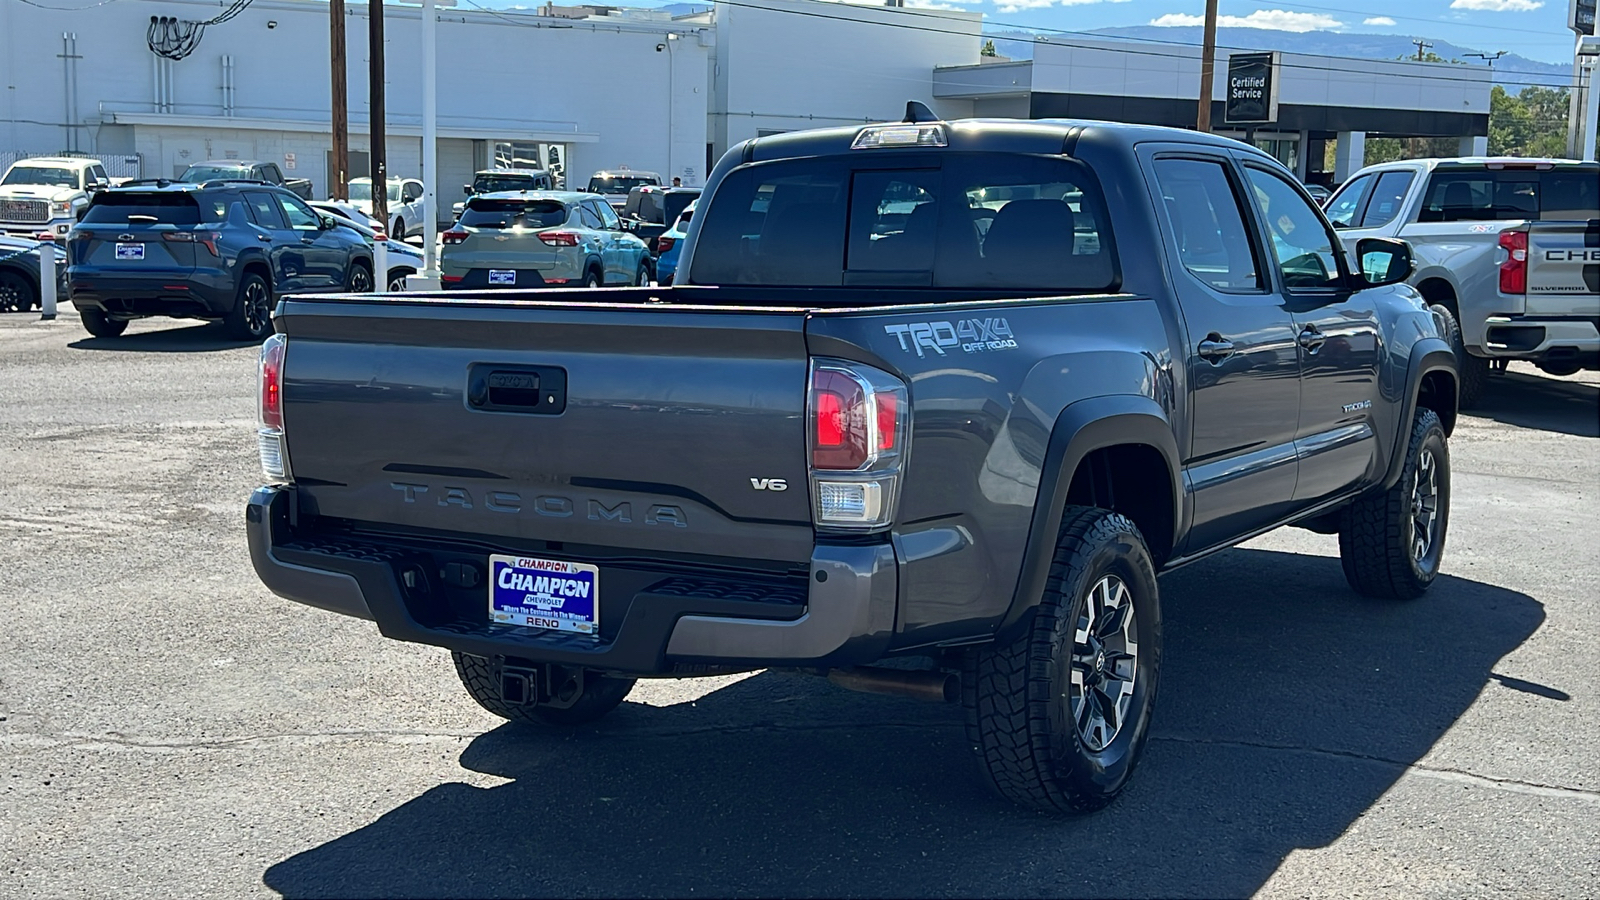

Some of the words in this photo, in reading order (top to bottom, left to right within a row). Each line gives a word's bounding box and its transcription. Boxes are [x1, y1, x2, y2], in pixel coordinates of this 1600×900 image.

[1231, 76, 1265, 88] Certified
[1232, 88, 1262, 99] Service
[884, 321, 960, 358] TRD
[962, 343, 986, 354] OFF
[986, 339, 1018, 351] ROAD
[750, 477, 788, 491] V6
[390, 482, 687, 527] TACOMA
[518, 559, 568, 572] CHAMPION
[498, 567, 590, 598] CHAMPION
[526, 595, 562, 606] CHEVROLET
[520, 606, 529, 614] The
[559, 611, 568, 619] The
[526, 616, 559, 628] RENO
